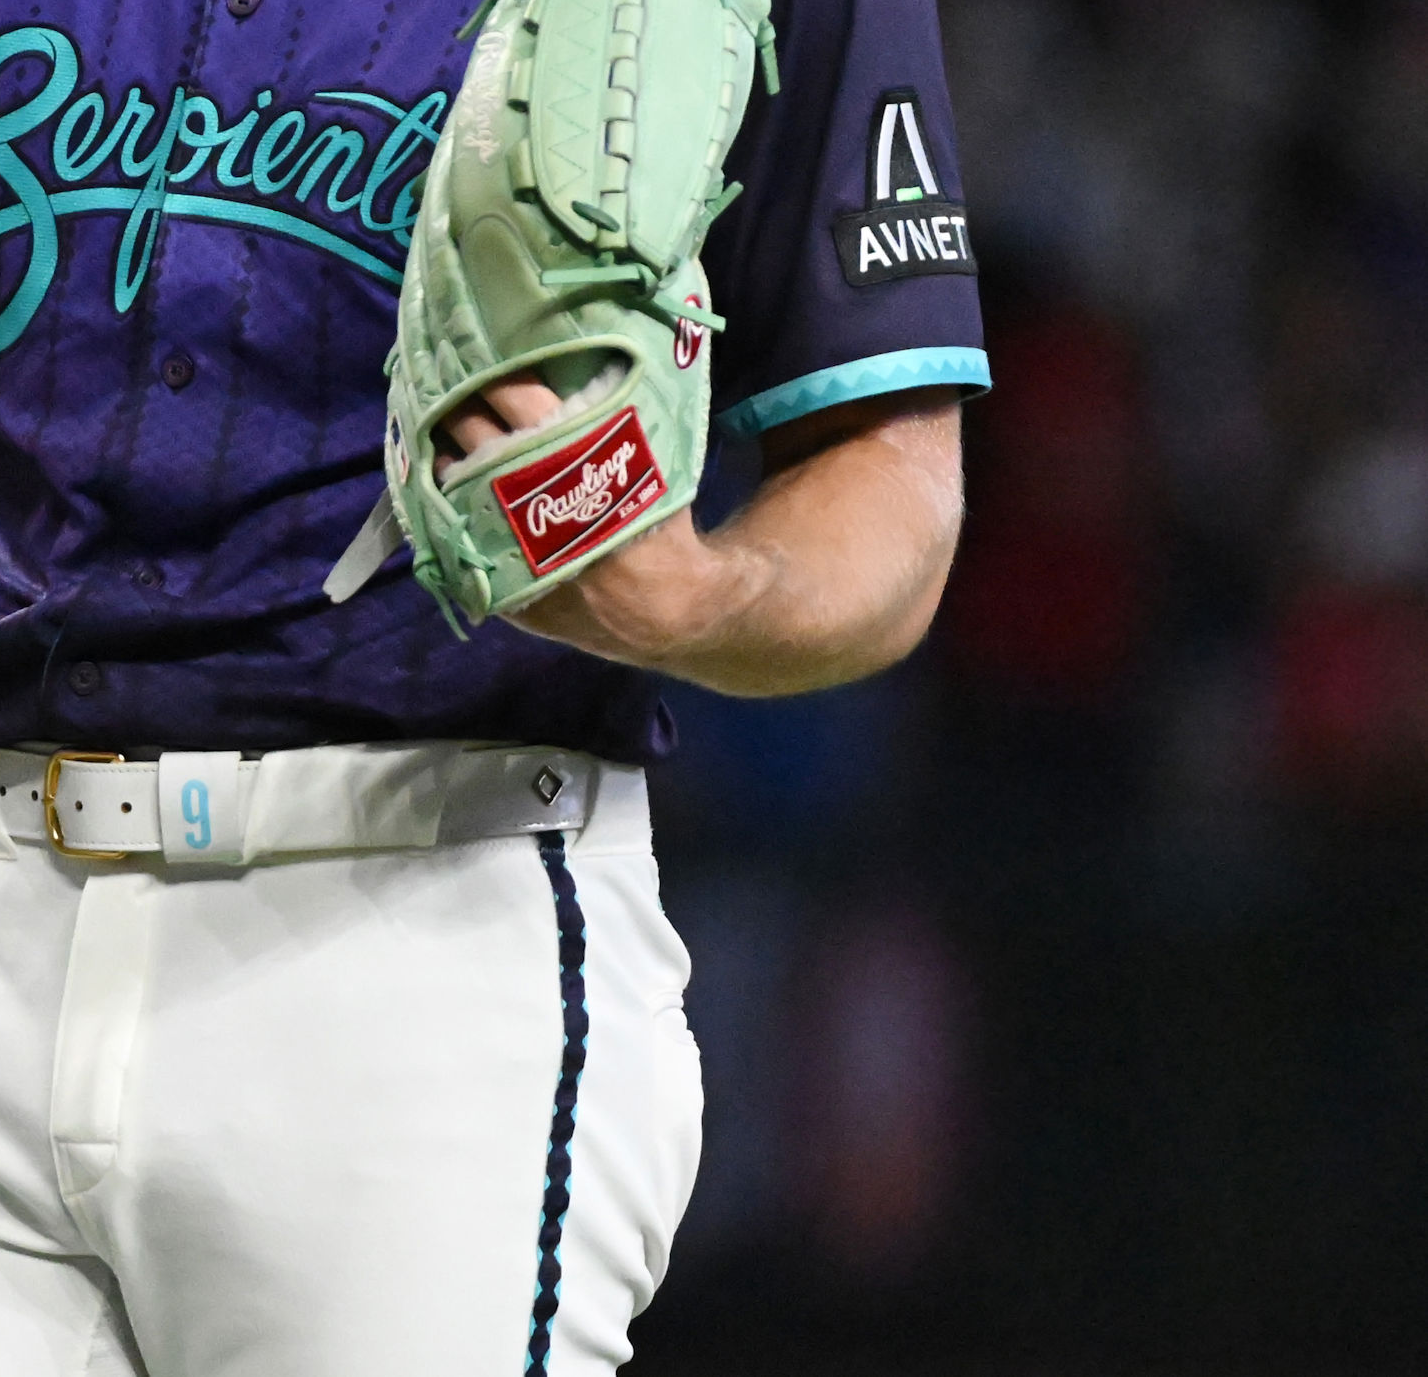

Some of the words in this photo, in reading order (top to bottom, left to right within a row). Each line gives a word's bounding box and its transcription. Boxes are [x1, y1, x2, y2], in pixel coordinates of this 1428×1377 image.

[859, 216, 968, 273] AVNET
[527, 441, 637, 537] Rawlings
[181, 779, 212, 850] 9
